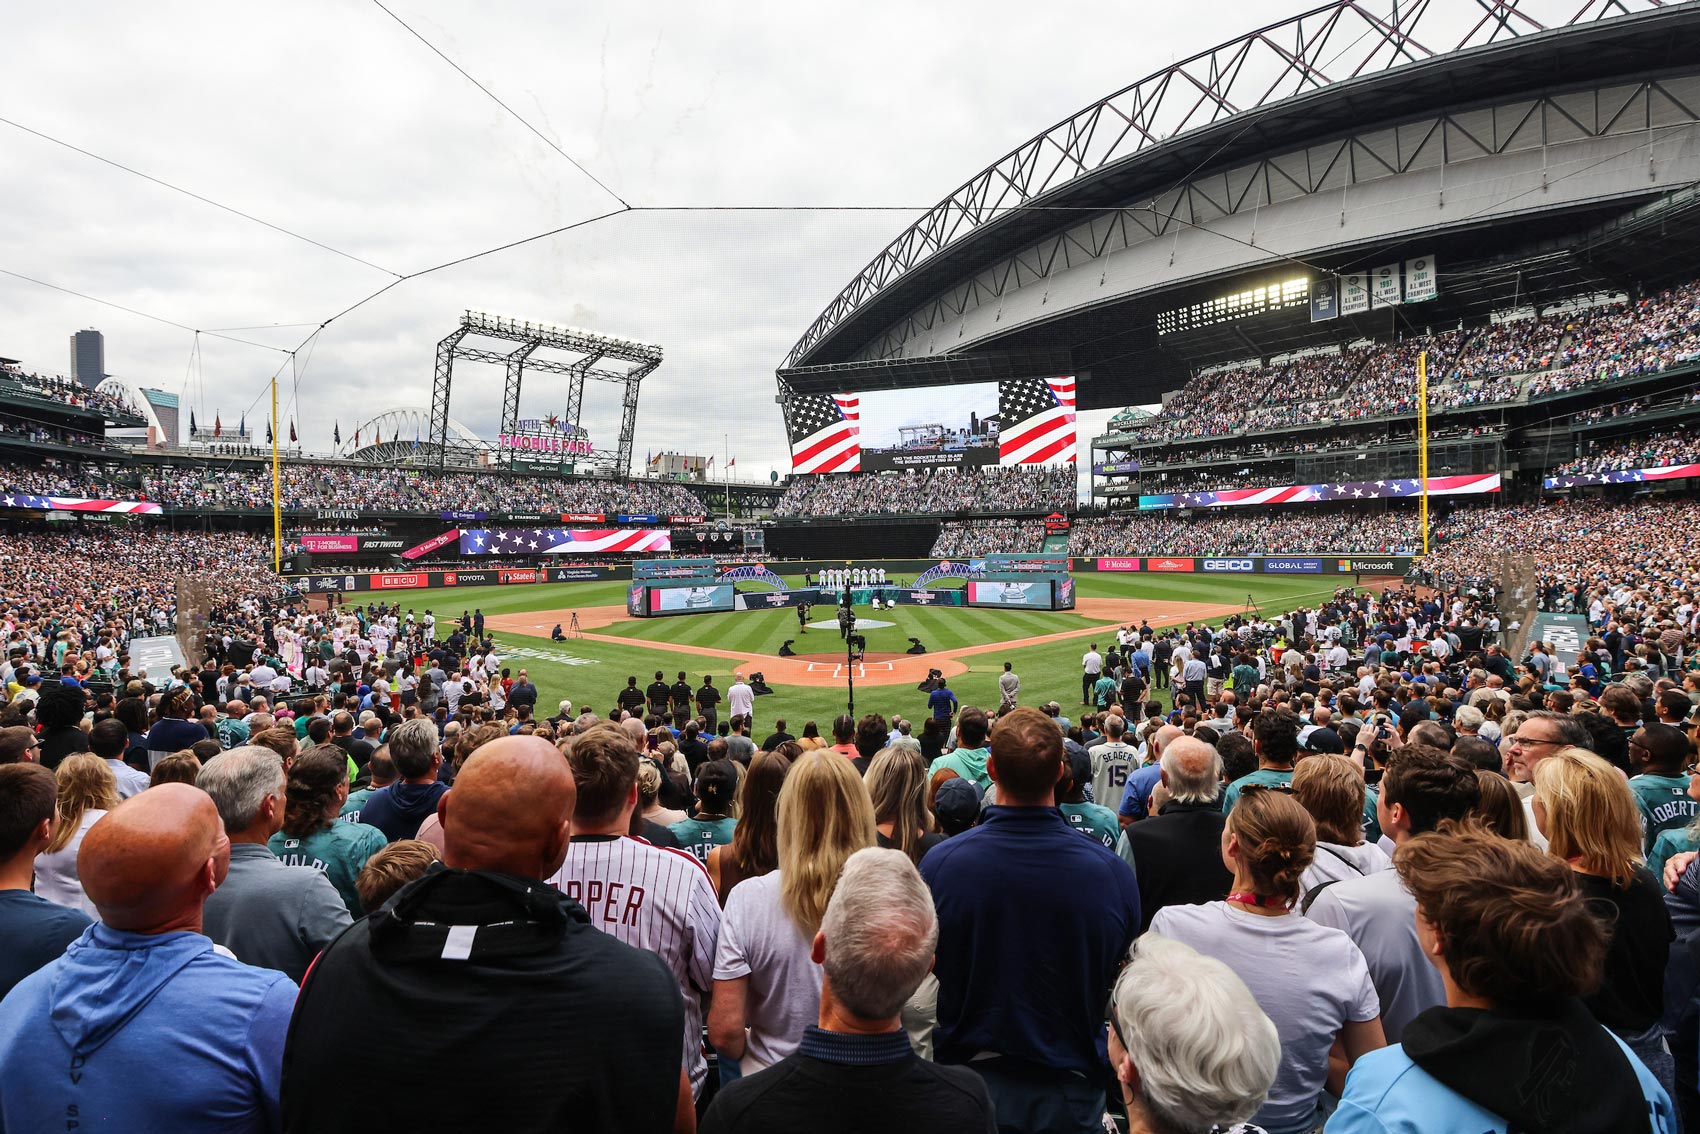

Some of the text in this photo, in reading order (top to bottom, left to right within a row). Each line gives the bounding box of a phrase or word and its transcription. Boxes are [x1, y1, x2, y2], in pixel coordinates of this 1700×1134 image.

[508, 419, 588, 438] SEATTLE MARINERS
[498, 433, 593, 454] T-MOBILE PARK
[1111, 560, 1132, 568] Mobile
[1203, 560, 1253, 570] GEICO
[1352, 561, 1394, 570] Microsoft
[384, 577, 415, 585] BECU
[1102, 750, 1133, 763] SEAGER
[1107, 764, 1128, 788] 15
